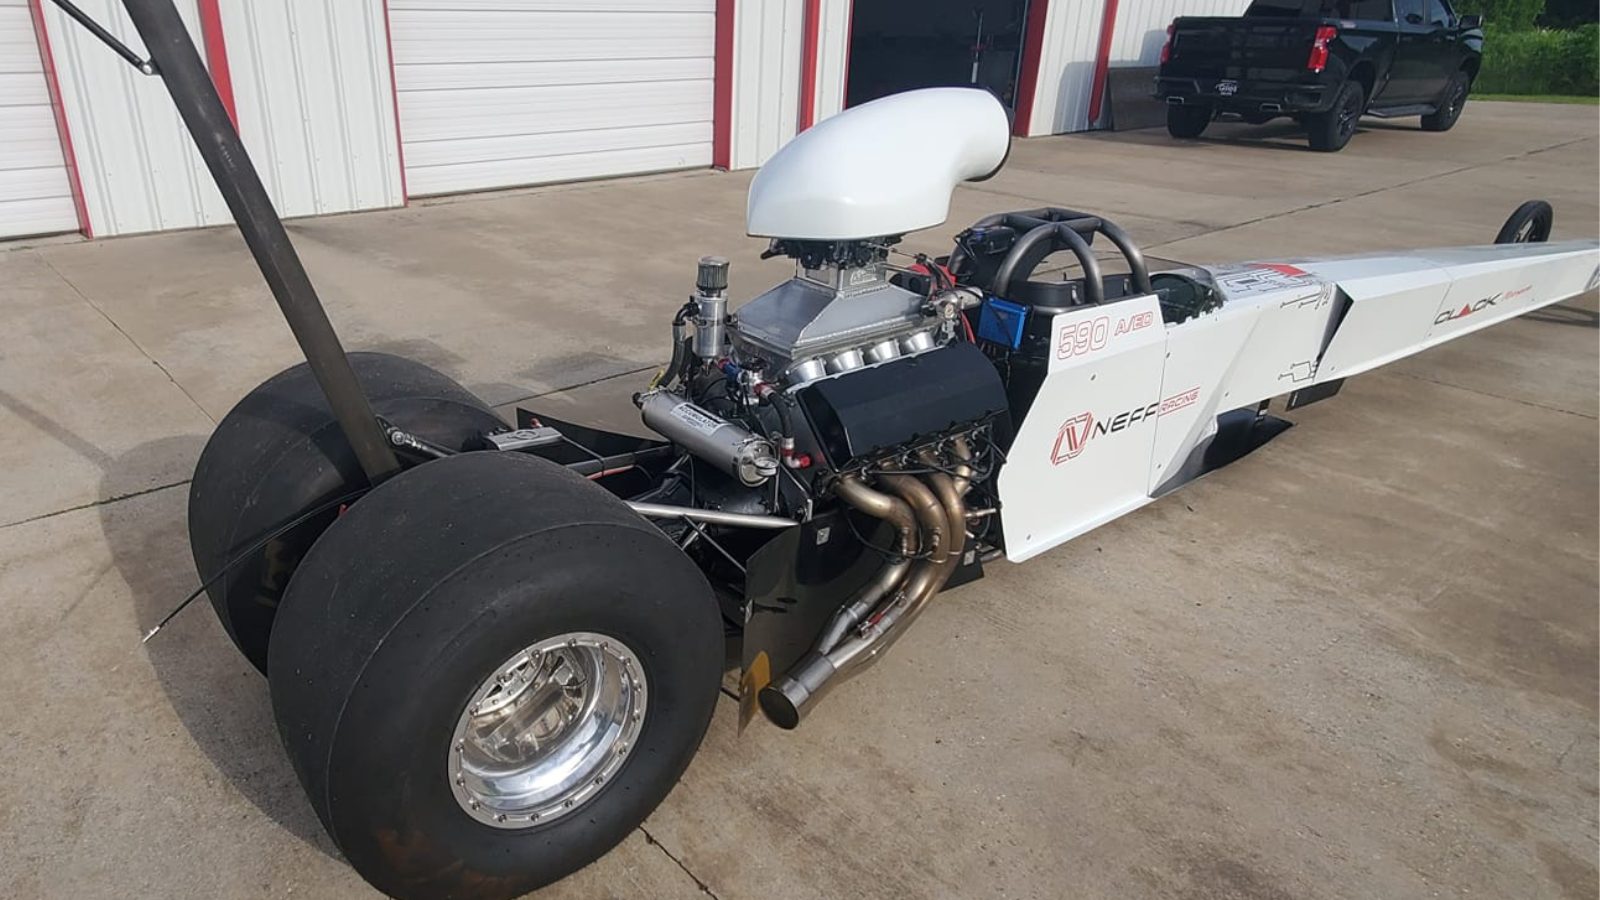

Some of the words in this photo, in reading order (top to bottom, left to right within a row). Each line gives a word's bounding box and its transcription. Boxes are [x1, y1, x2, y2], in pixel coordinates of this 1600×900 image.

[1057, 316, 1110, 360] 590
[1092, 402, 1160, 440] NEFF
[1160, 391, 1200, 412] RACING
